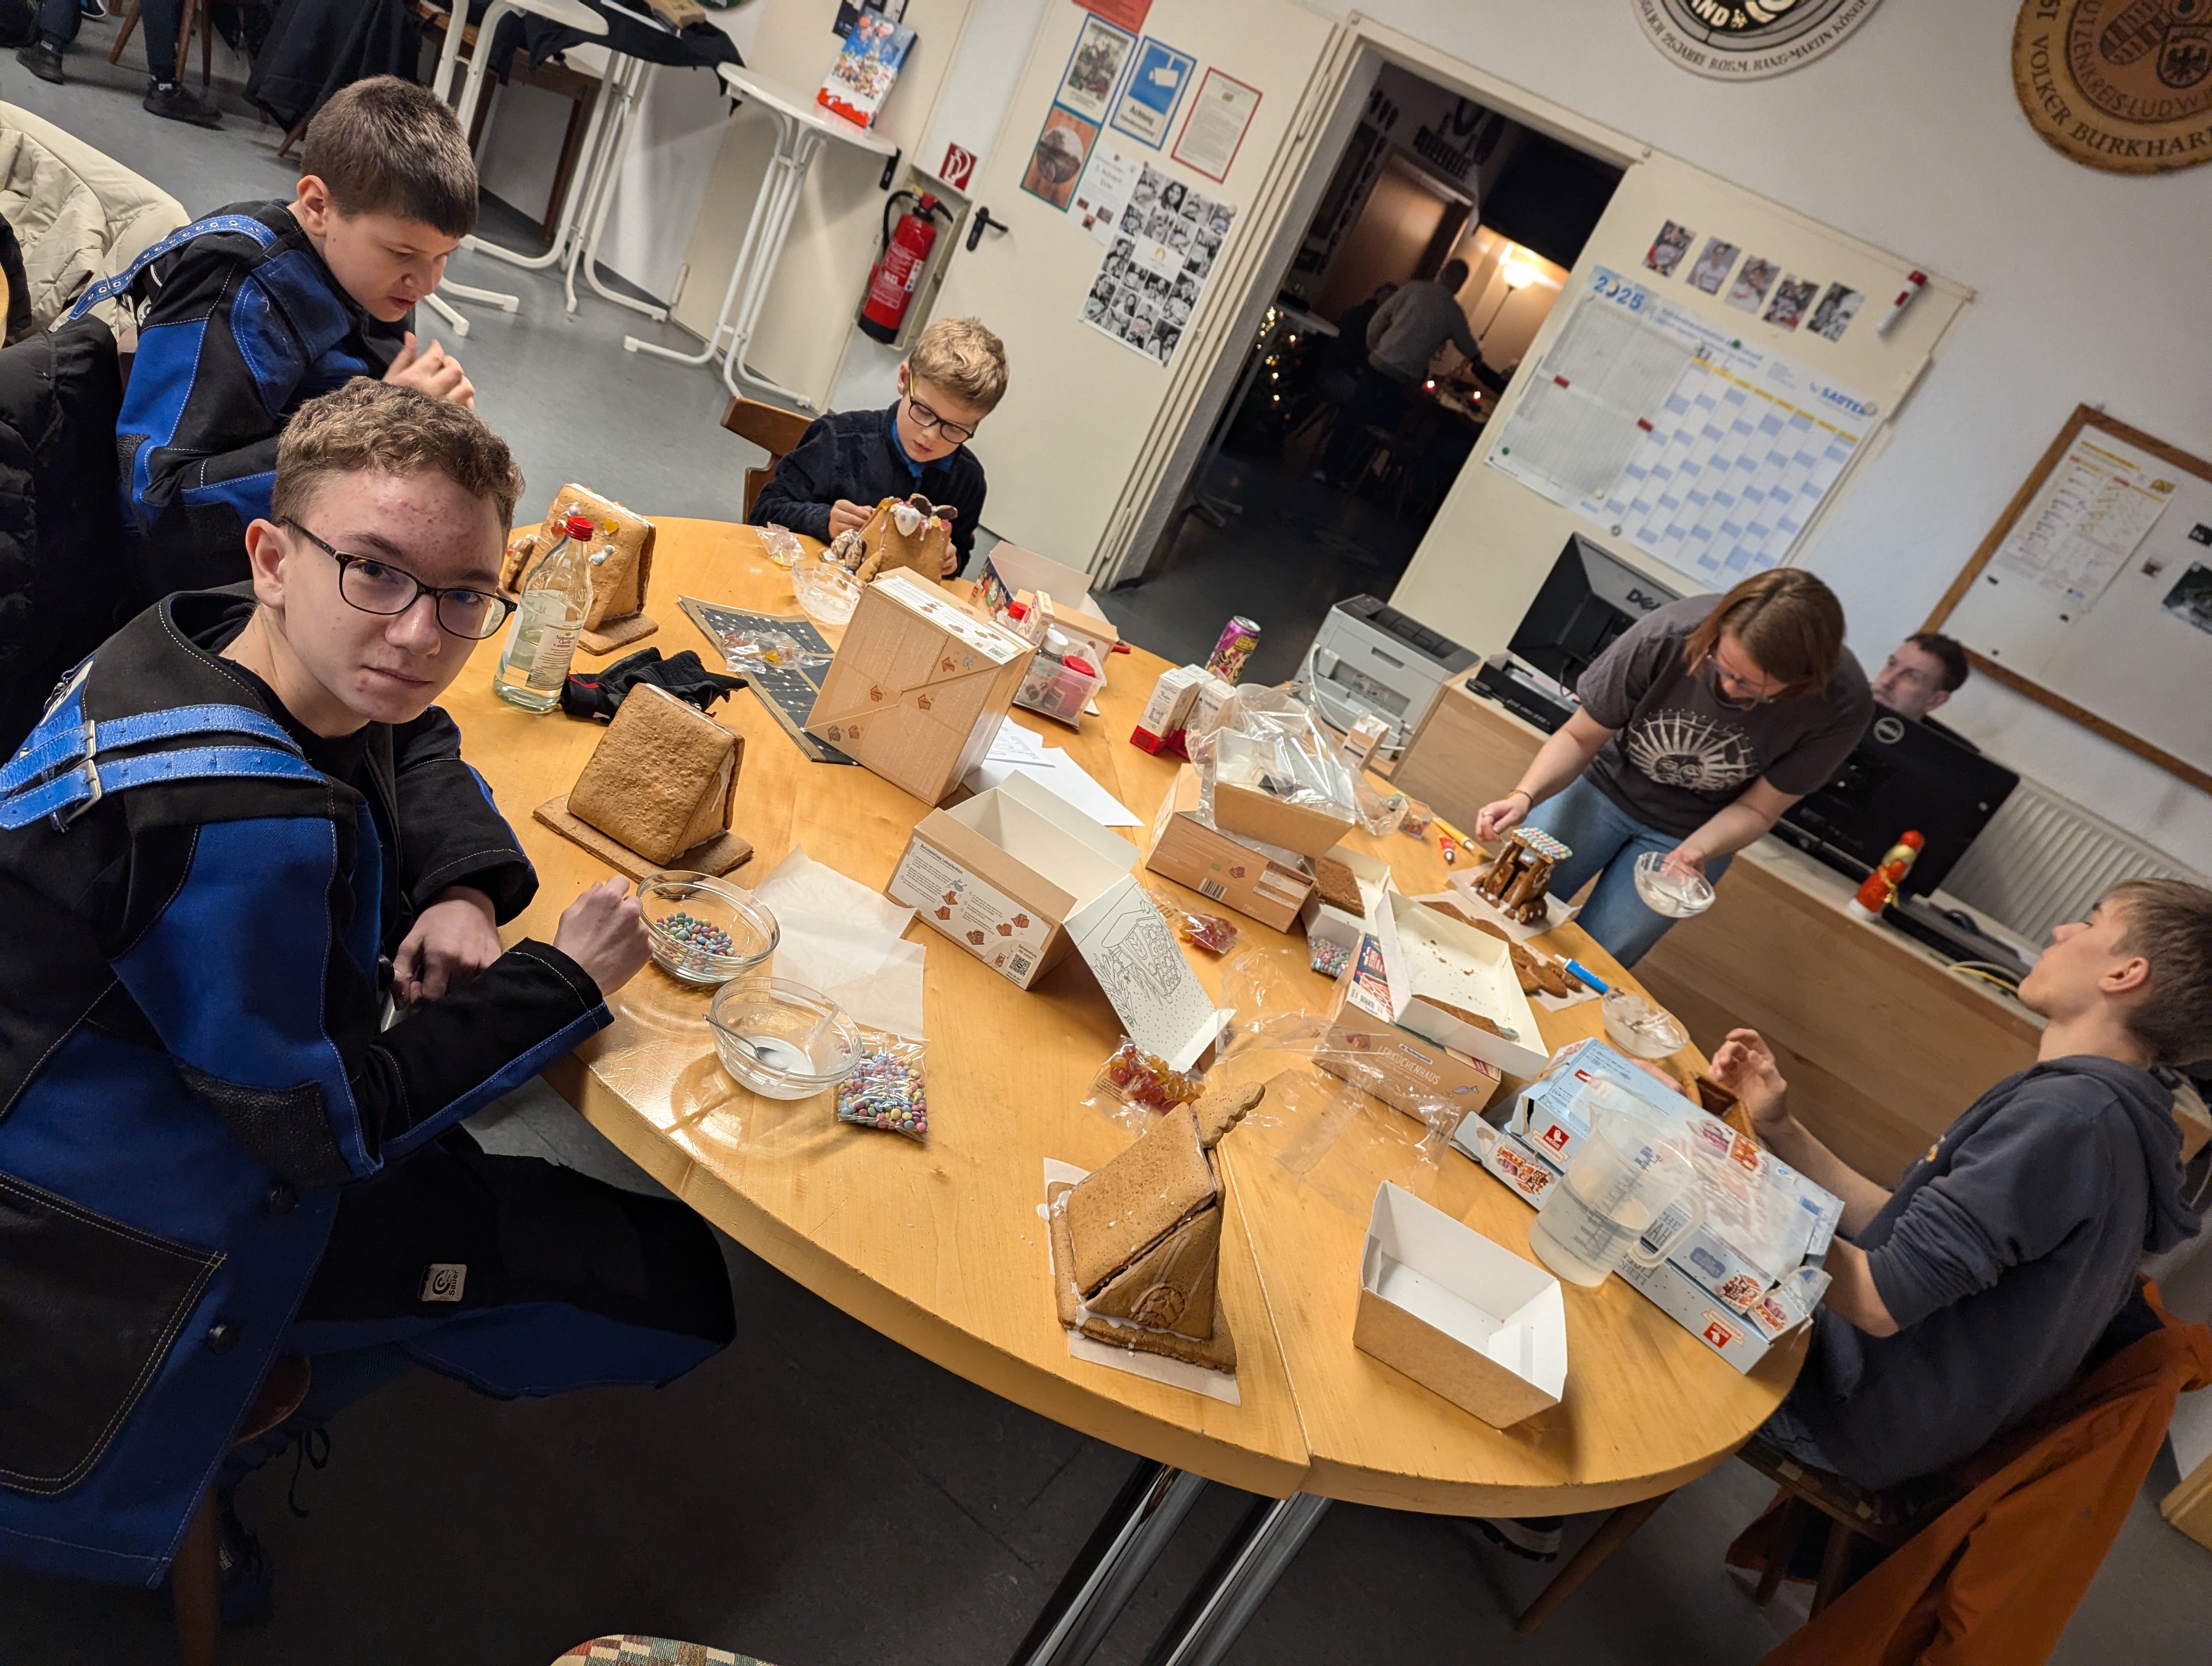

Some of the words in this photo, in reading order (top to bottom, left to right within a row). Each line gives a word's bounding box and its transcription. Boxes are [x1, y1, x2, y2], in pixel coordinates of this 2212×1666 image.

[2029, 34, 2072, 127] VOLKER
[1626, 587, 1662, 612] DEL
[448, 1270, 459, 1296] Sauer
